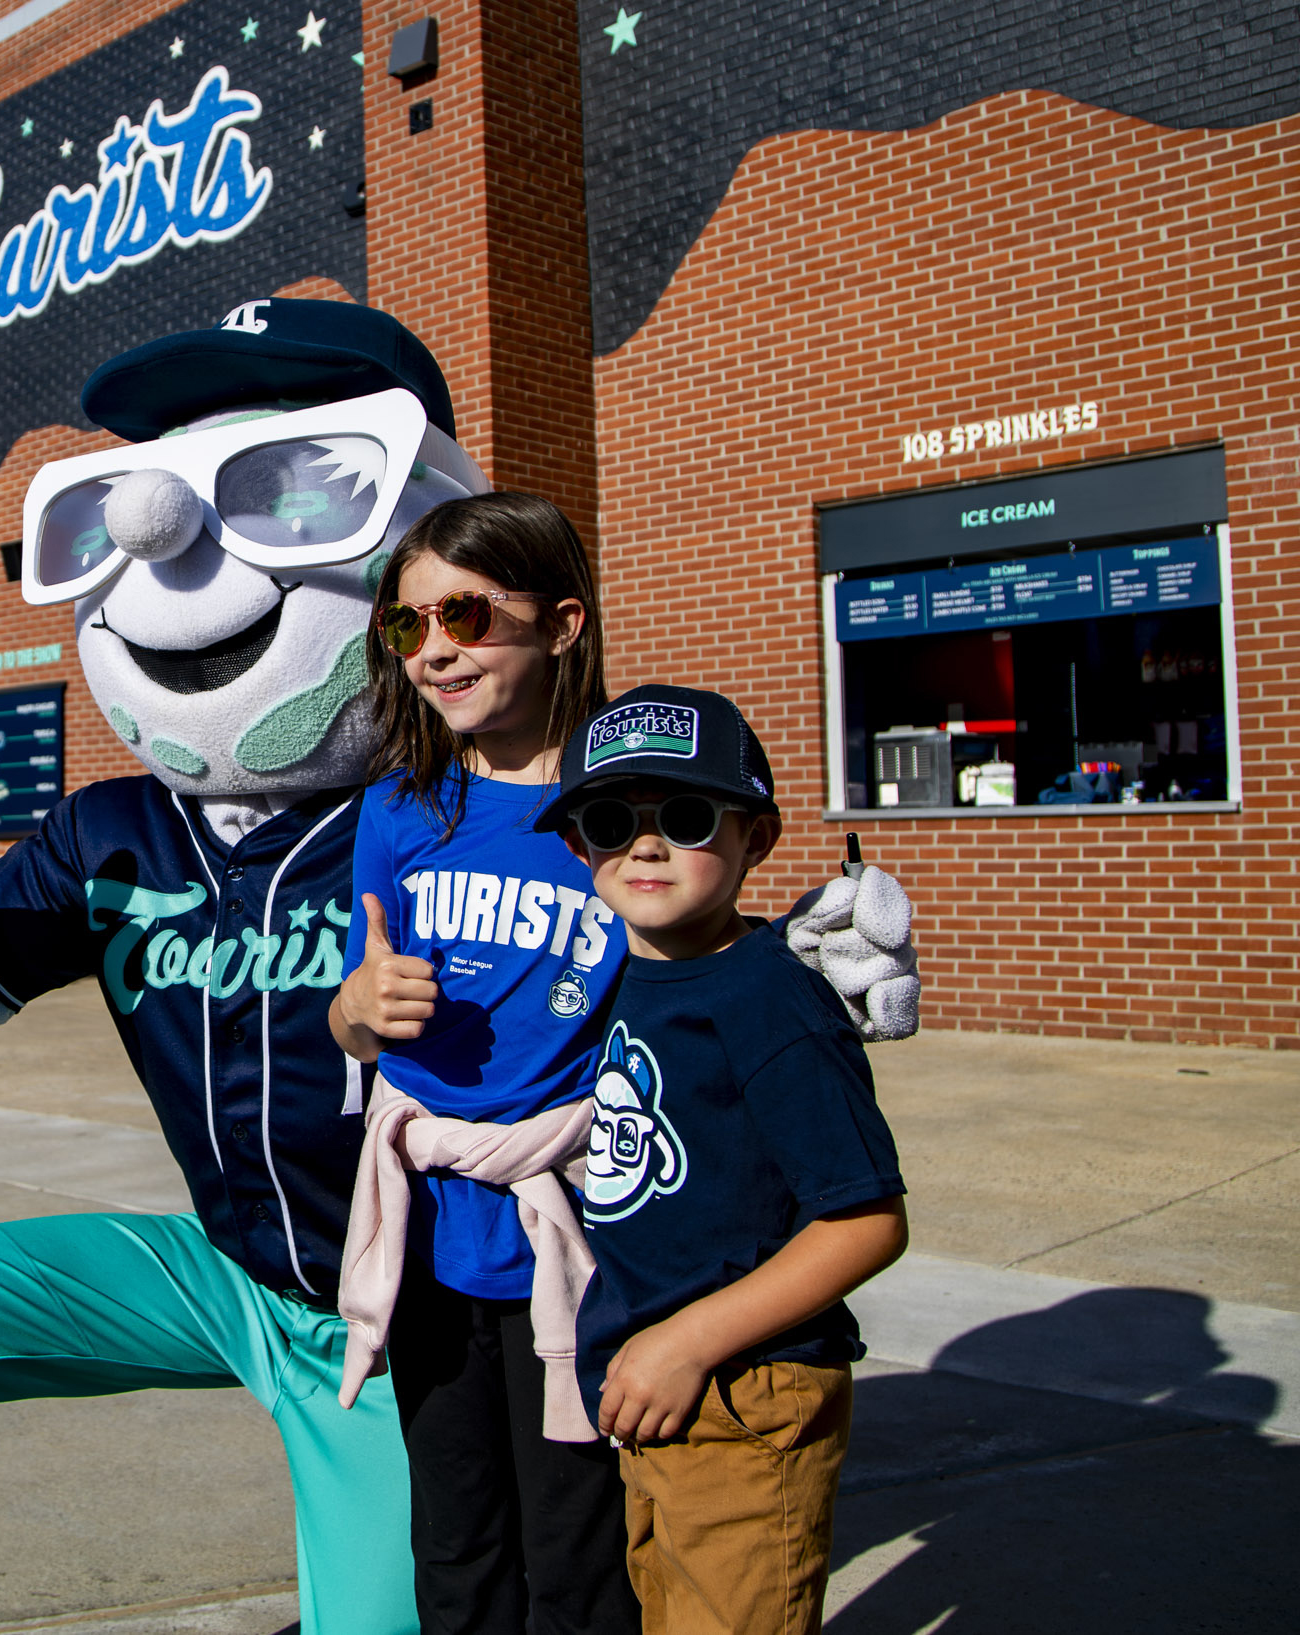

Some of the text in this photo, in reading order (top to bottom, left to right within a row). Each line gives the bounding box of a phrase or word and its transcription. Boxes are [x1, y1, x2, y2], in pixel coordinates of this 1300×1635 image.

[903, 401, 1099, 463] 108 SPRINKLES
[961, 499, 1055, 528] ICE CREAM
[593, 712, 691, 748] Tourists
[595, 707, 690, 729] ASHEVILLE
[85, 878, 352, 1015] Touris
[450, 965, 476, 975] Baseball
[452, 956, 493, 969] Minor League
